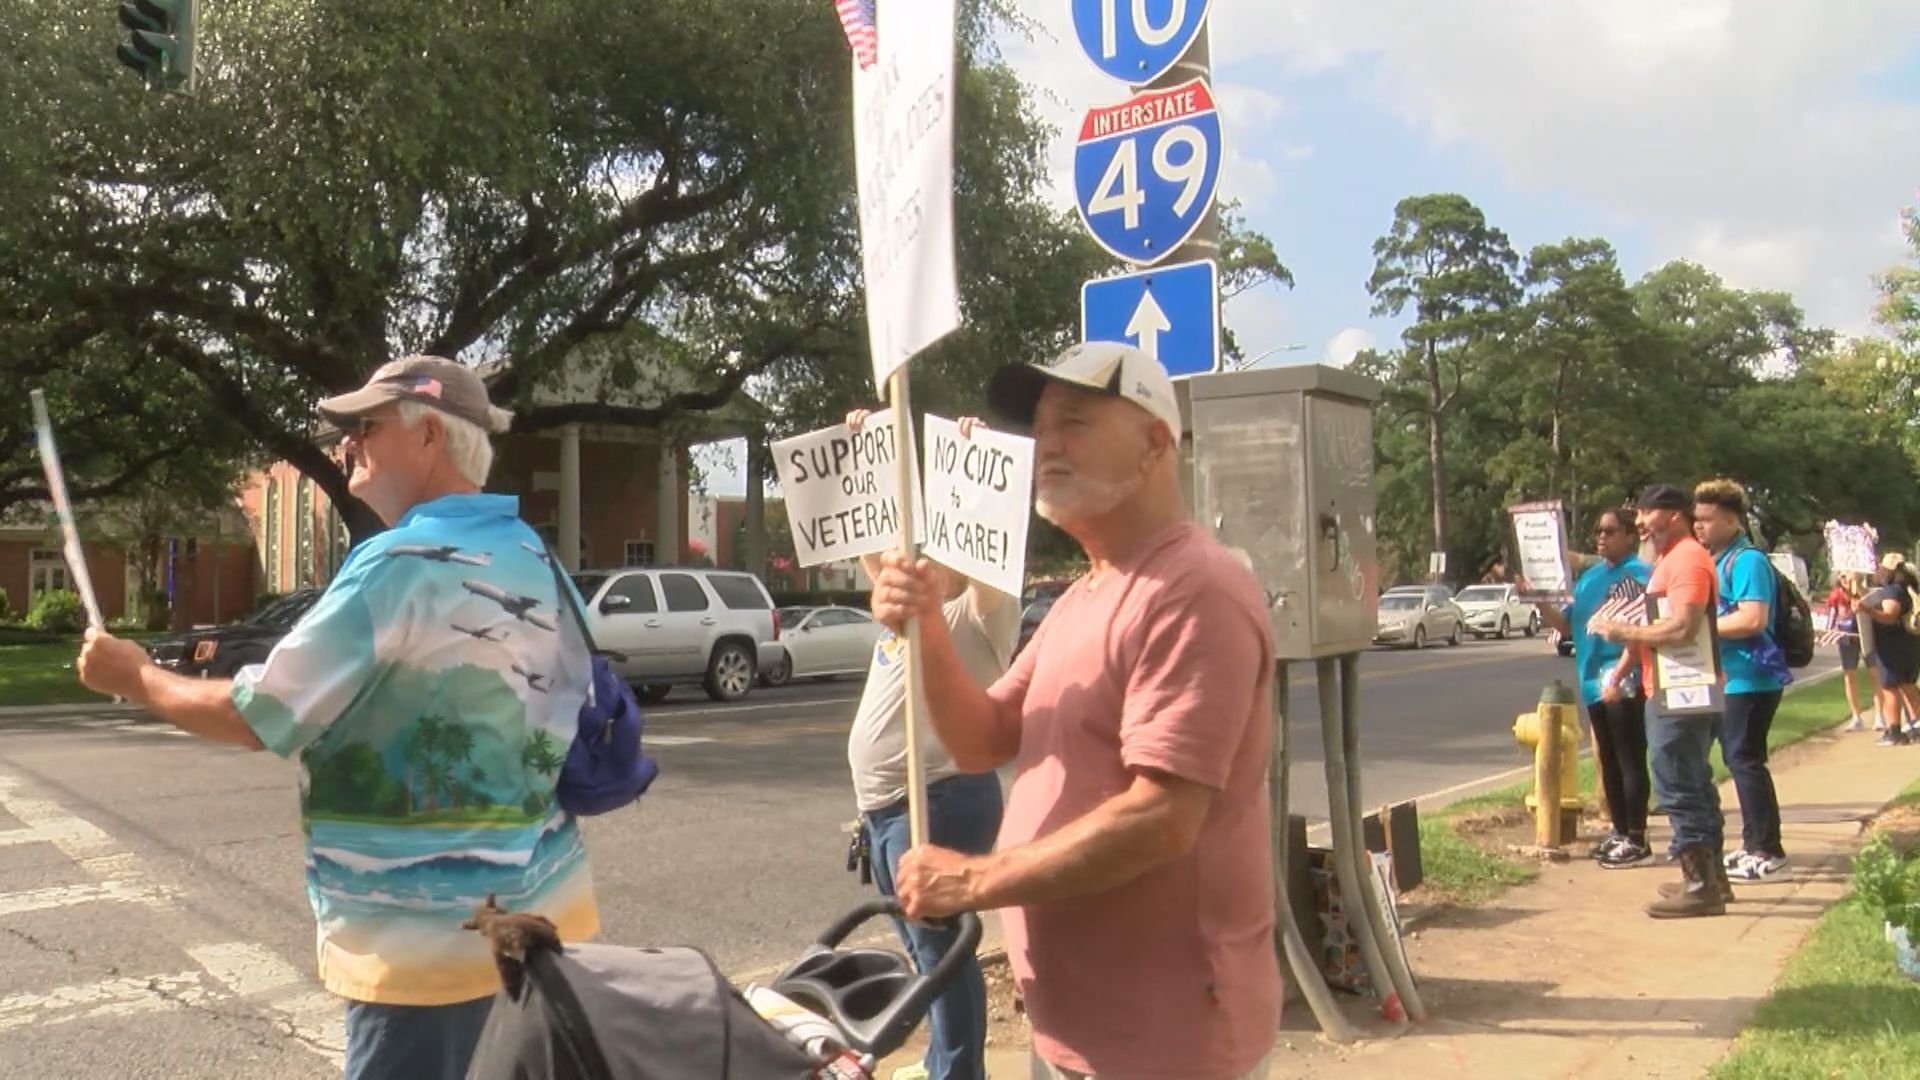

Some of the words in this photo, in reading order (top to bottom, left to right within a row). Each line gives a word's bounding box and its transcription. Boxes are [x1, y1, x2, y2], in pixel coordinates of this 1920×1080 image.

[1093, 91, 1197, 136] INTERSTATE
[1087, 125, 1209, 230] 49
[790, 424, 896, 483] SUPPORT
[934, 436, 957, 474] NO
[963, 444, 1013, 492] CUTS
[842, 471, 877, 496] OUR
[950, 485, 960, 508] to
[929, 508, 950, 550] VA
[955, 521, 1009, 570] CARE!
